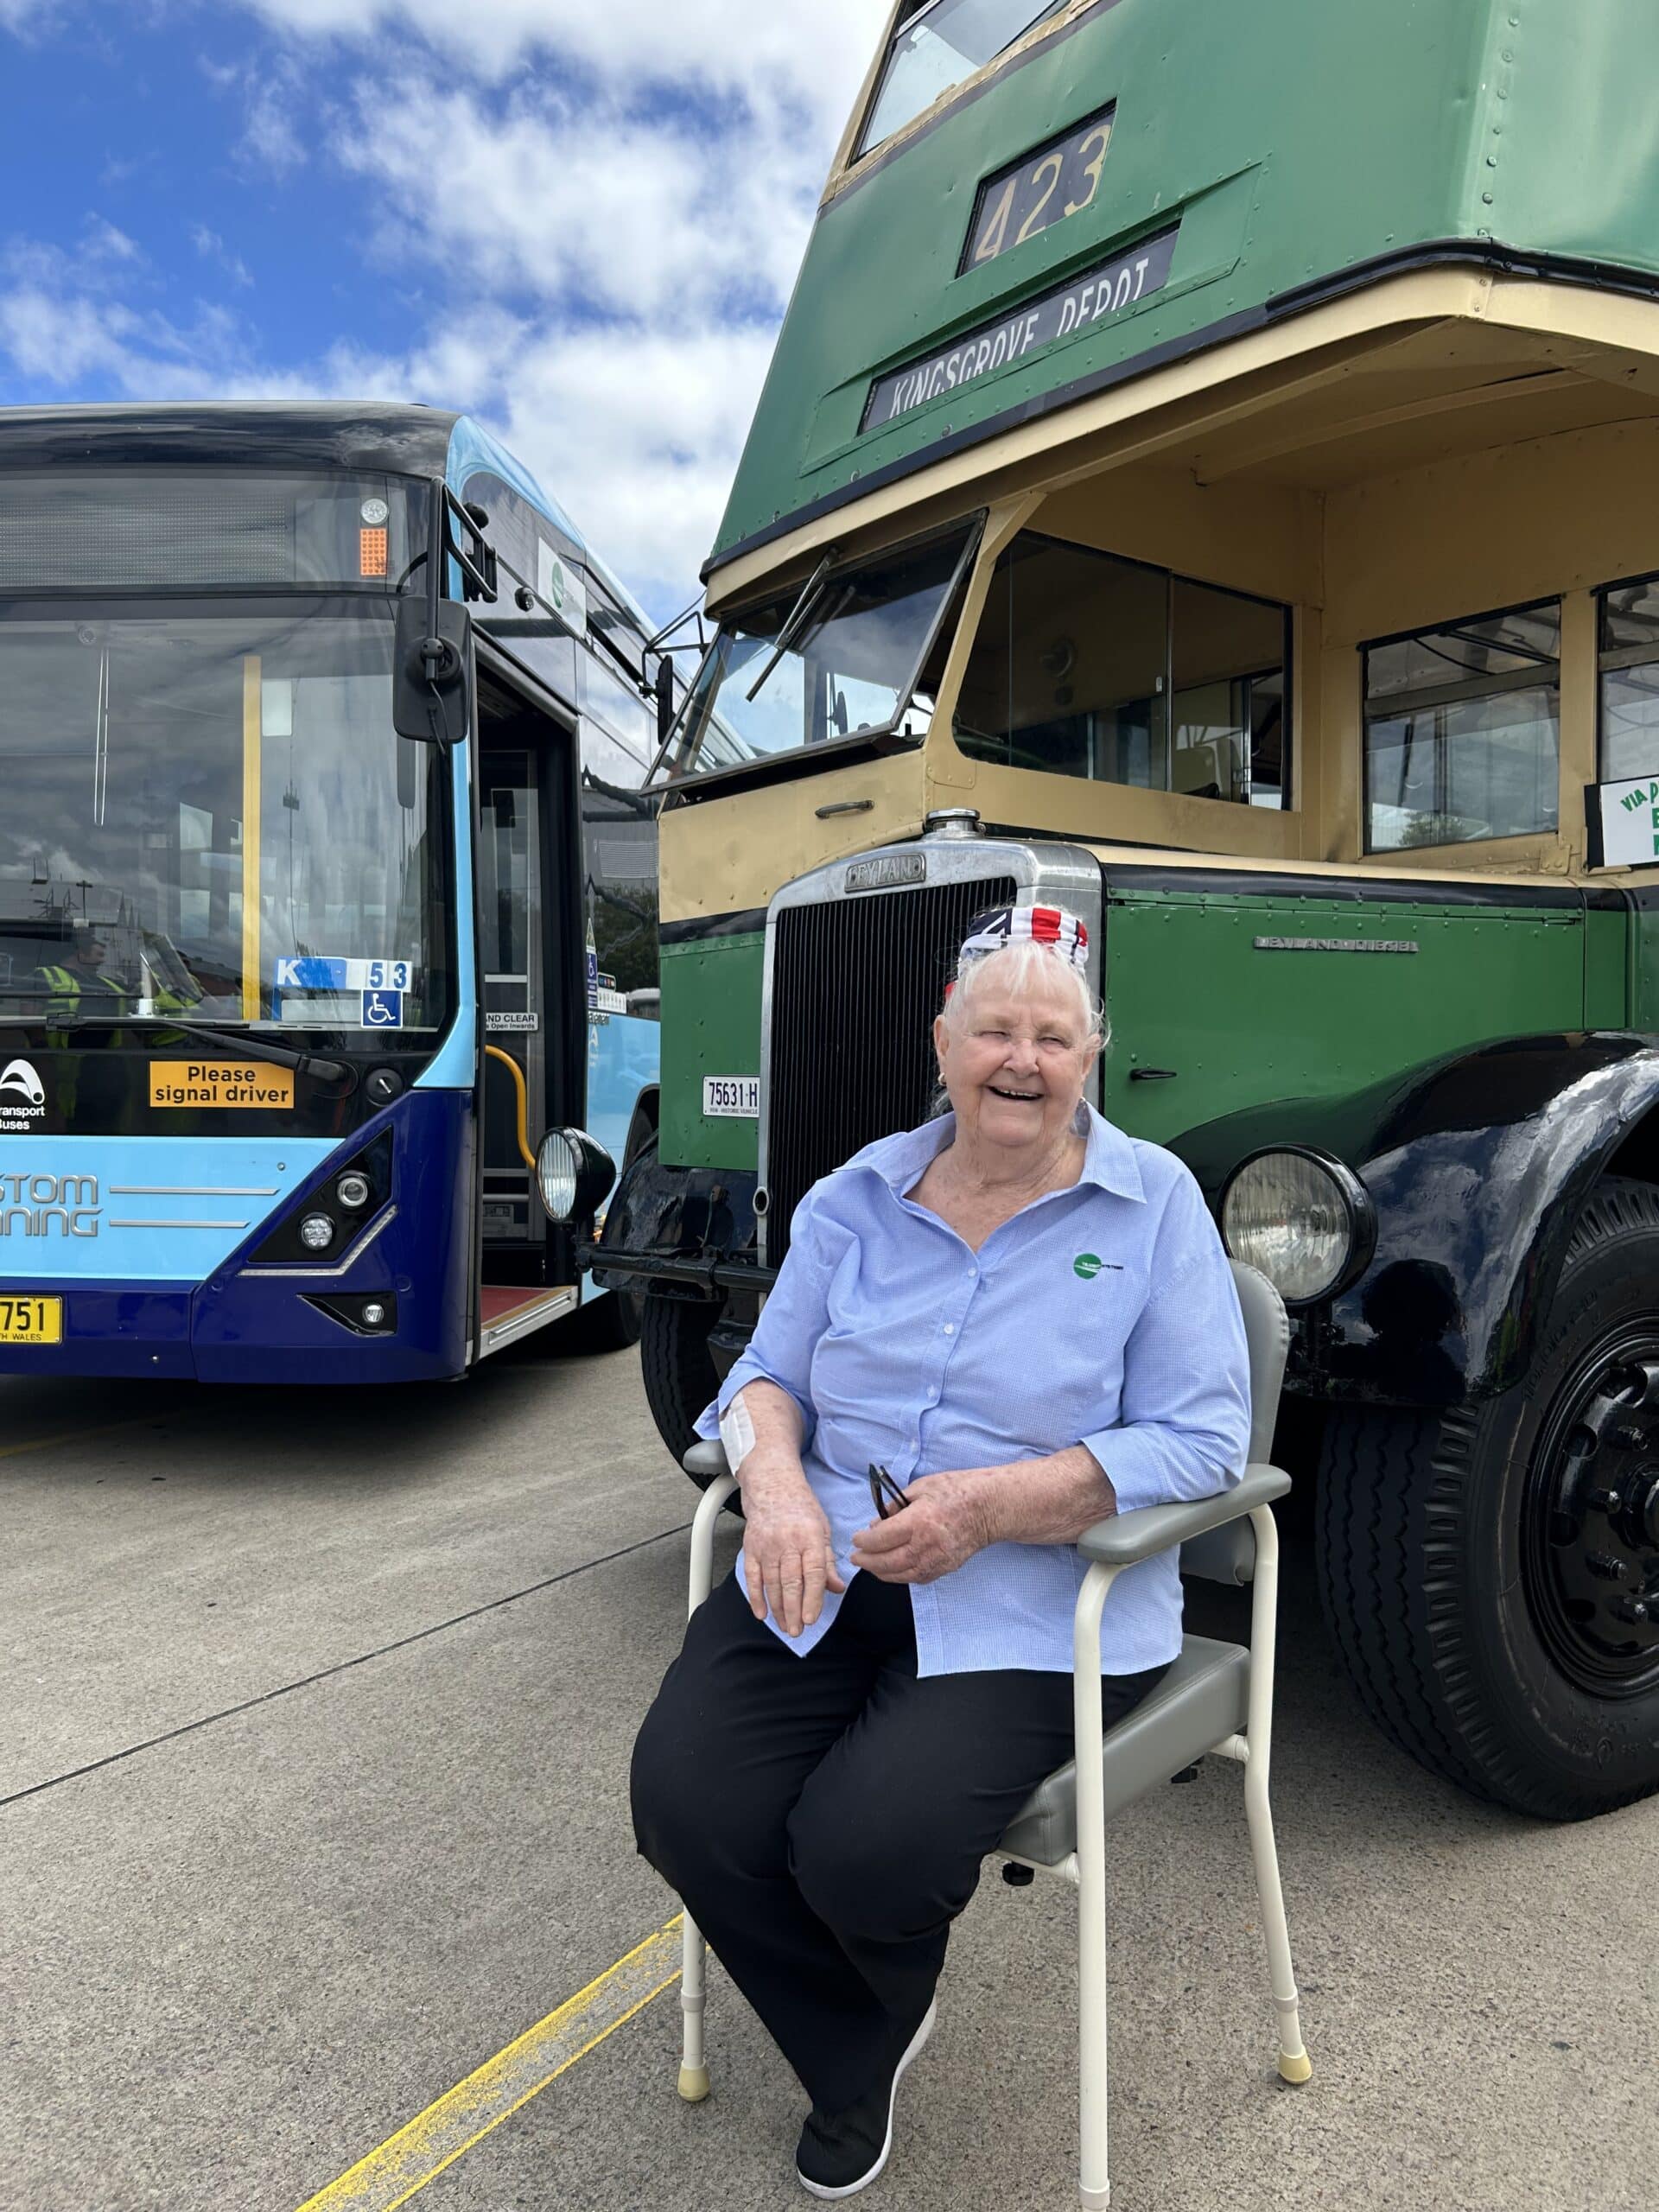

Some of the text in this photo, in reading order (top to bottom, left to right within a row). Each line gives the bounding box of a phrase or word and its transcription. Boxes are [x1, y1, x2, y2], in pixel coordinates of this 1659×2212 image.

[975, 124, 1112, 262] 423
[889, 257, 1150, 420] KINGSGROVE DEPOT
[1620, 789, 1648, 811] VIA
[188, 1065, 256, 1082] Please
[156, 1085, 289, 1103] signal driver
